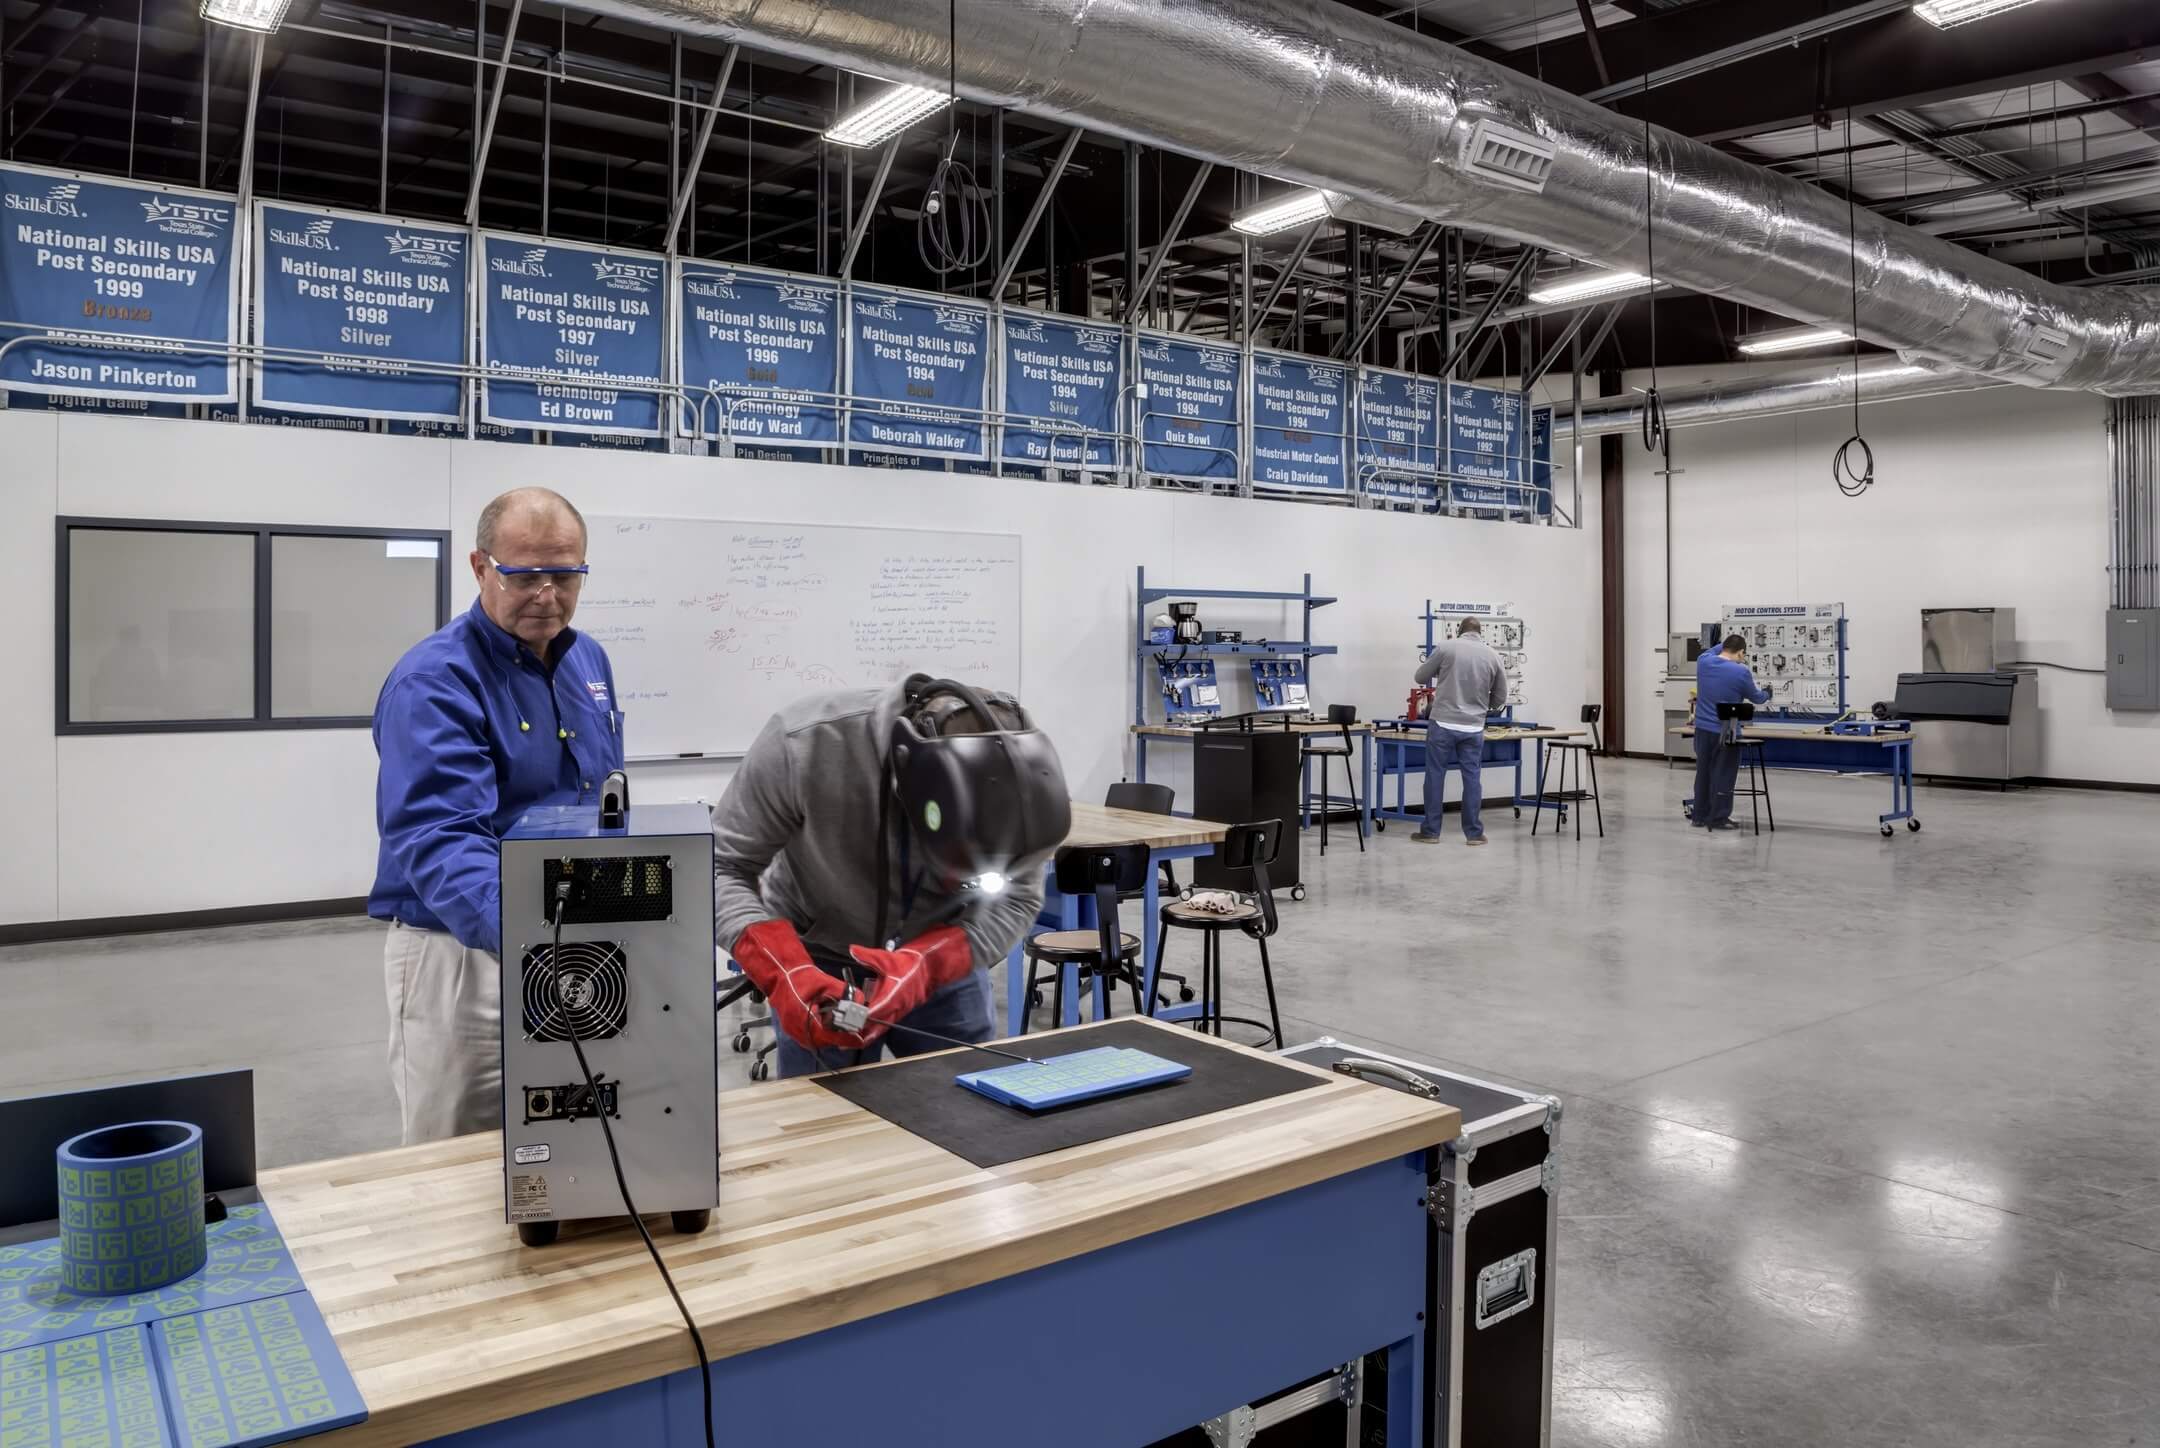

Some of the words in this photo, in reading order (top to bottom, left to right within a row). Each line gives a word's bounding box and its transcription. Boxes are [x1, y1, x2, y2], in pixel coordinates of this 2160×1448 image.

[167, 203, 229, 222] TSTC
[159, 224, 189, 234] Technical
[170, 220, 186, 229] Texas
[187, 222, 204, 230] State
[18, 225, 106, 253] National
[114, 237, 171, 260] Skills
[177, 245, 215, 265] USA
[409, 236, 461, 253] TSTC
[37, 249, 84, 271] Post
[91, 256, 197, 286] Secondary
[281, 257, 356, 283] National
[363, 269, 412, 289] Skills
[417, 274, 450, 293] USA
[612, 262, 658, 279] TSTC
[94, 278, 144, 299] 1999
[298, 279, 338, 300] Post
[344, 286, 434, 313] Secondary
[501, 284, 567, 307] National
[573, 294, 616, 313] Skills
[620, 299, 650, 316] USA
[82, 300, 152, 321] Bronze
[345, 306, 388, 325] 1998
[516, 305, 552, 323] Post
[556, 310, 636, 335] Secondary
[696, 305, 753, 327] National
[758, 314, 796, 332] Skills
[800, 320, 826, 335] USA
[340, 326, 392, 347] Silver
[558, 329, 596, 346] 1997
[709, 325, 740, 342] Post
[744, 330, 814, 353] Secondary
[862, 326, 913, 347] National
[917, 335, 951, 352] Skills
[954, 340, 976, 355] USA
[555, 349, 599, 367] Silver
[746, 348, 779, 364] 1996
[874, 343, 901, 360] Post
[904, 349, 965, 372] Secondary
[1014, 348, 1058, 367] National
[1061, 355, 1090, 371] Skills
[1093, 360, 1114, 373] USA
[31, 359, 92, 381] Jason
[100, 365, 197, 388] Pinkerton
[906, 366, 935, 381] 1994
[1023, 365, 1048, 380] Post
[1050, 369, 1104, 389] Secondary
[1144, 368, 1183, 385] National
[1185, 374, 1211, 389] Skills
[1214, 379, 1232, 391] USA
[535, 383, 619, 405] Technology
[1051, 384, 1077, 399] 1994
[1153, 383, 1173, 397] Post
[1175, 386, 1224, 406] Secondary
[1258, 384, 1293, 399] National
[1296, 390, 1319, 403] Skills
[1321, 393, 1338, 406] USA
[106, 396, 149, 410] Game
[540, 401, 559, 418] Ed
[564, 403, 613, 422] Brown
[725, 397, 800, 419] Technology
[1049, 400, 1079, 415] Silver
[1177, 402, 1199, 415] 1994
[1265, 398, 1284, 411] Post
[1287, 400, 1330, 420] Secondary
[1394, 405, 1415, 418] Skills
[768, 420, 802, 435] Ward
[1288, 416, 1307, 428] 1994
[1367, 413, 1384, 426] Post
[1454, 413, 1482, 427] National
[1483, 418, 1502, 430] Skills
[872, 425, 922, 444] Deborah
[926, 431, 966, 449] Walker
[1166, 430, 1186, 443] Quiz
[1188, 433, 1210, 445] Bowl
[1459, 427, 1475, 438] Post
[1027, 442, 1048, 458] Ray
[1255, 445, 1289, 460] Industrial
[1292, 450, 1312, 463] Motor
[1314, 452, 1339, 465] Control
[1266, 467, 1289, 483] Craig
[1291, 470, 1328, 484] Davidson
[1757, 606, 1782, 614] CONTROL
